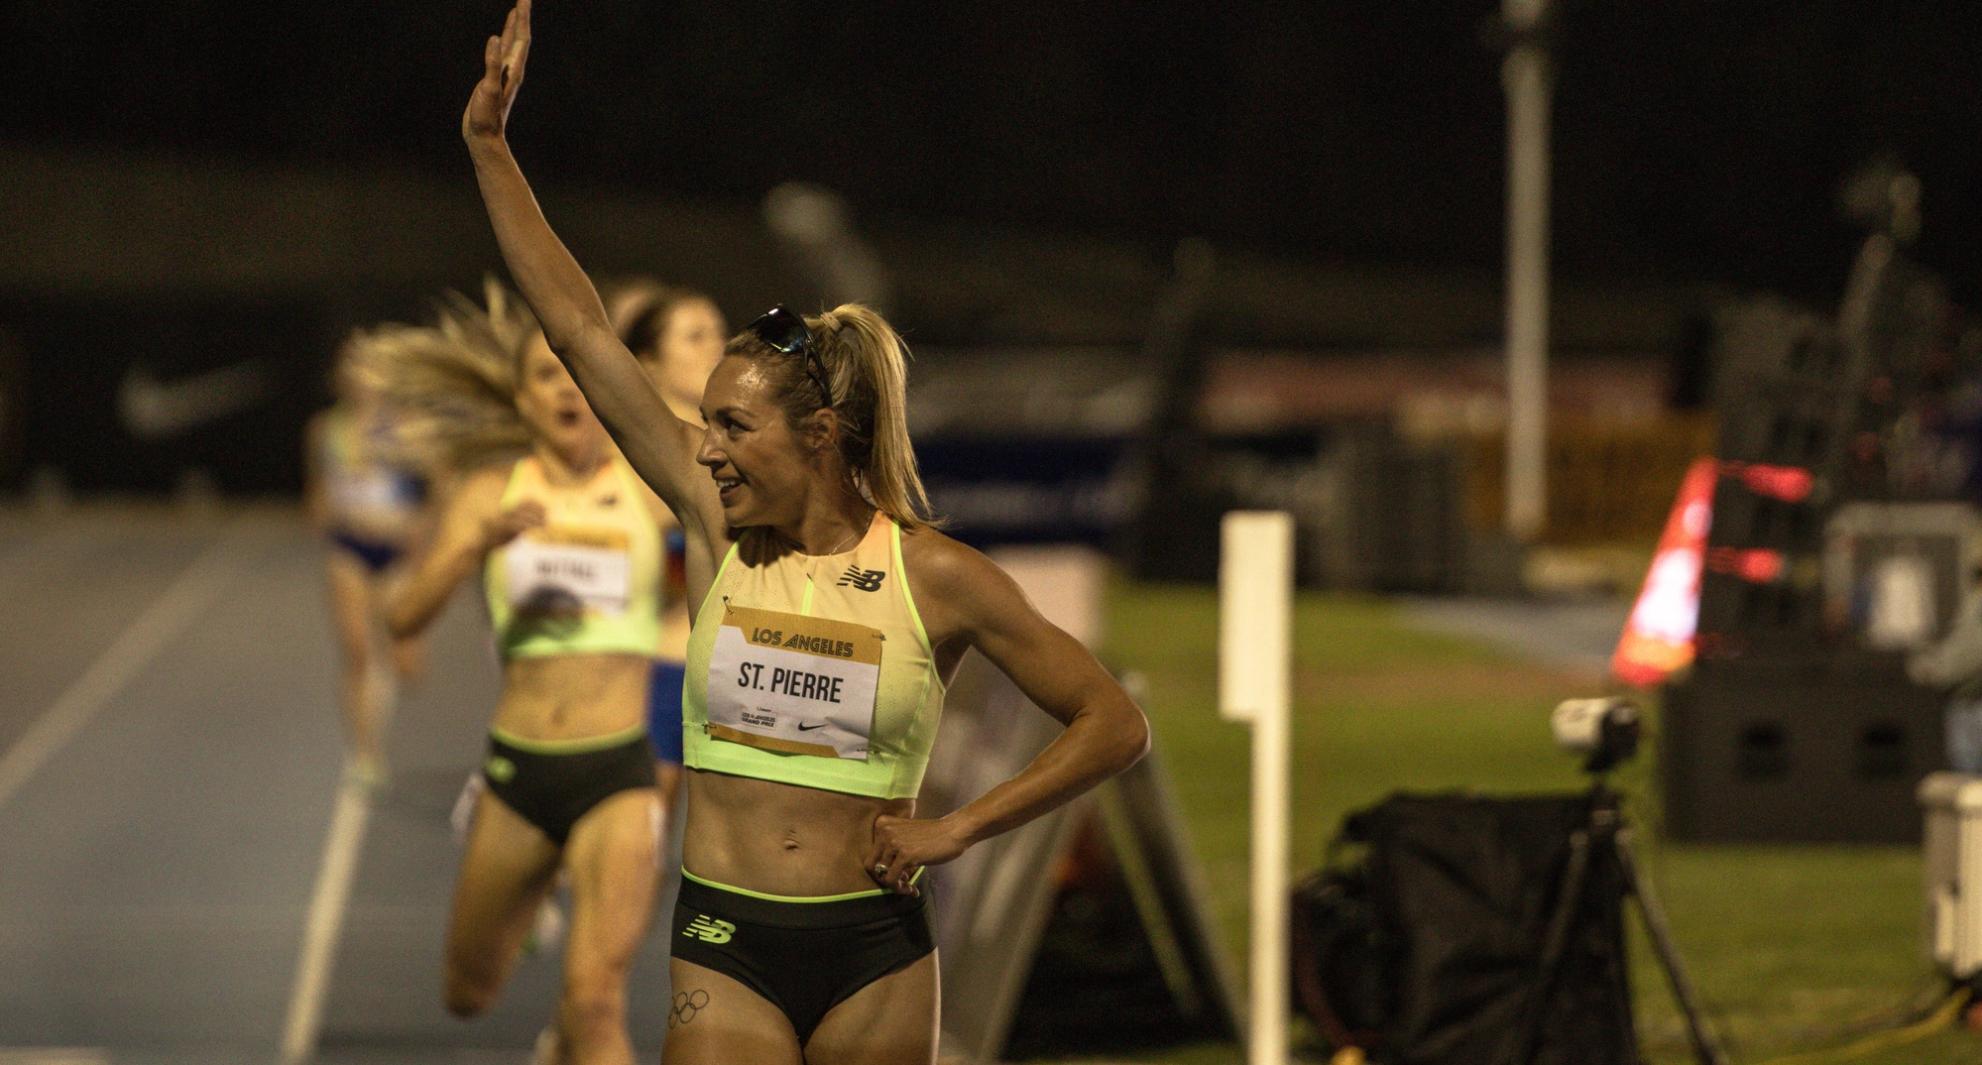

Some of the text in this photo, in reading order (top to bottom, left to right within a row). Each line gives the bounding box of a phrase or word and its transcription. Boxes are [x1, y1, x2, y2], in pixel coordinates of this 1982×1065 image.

[751, 627, 855, 658] LOS ANGELES
[737, 661, 844, 704] ST. PIERRE
